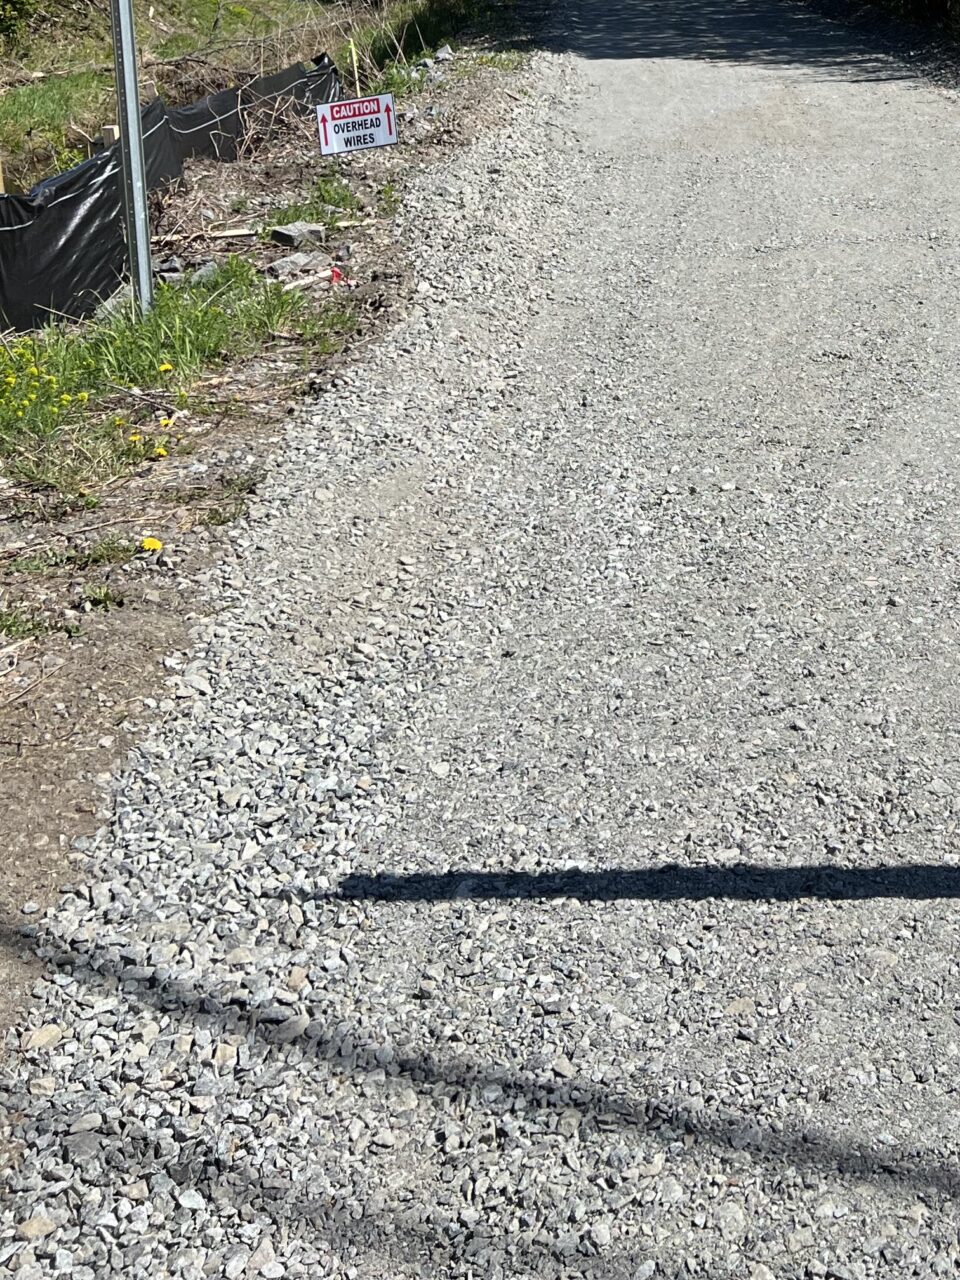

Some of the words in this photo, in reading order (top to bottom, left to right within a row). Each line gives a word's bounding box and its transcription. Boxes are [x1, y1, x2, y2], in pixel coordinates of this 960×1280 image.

[332, 100, 378, 118] CAUTION
[333, 117, 381, 134] OVERHEAD
[343, 133, 375, 148] WIRES
